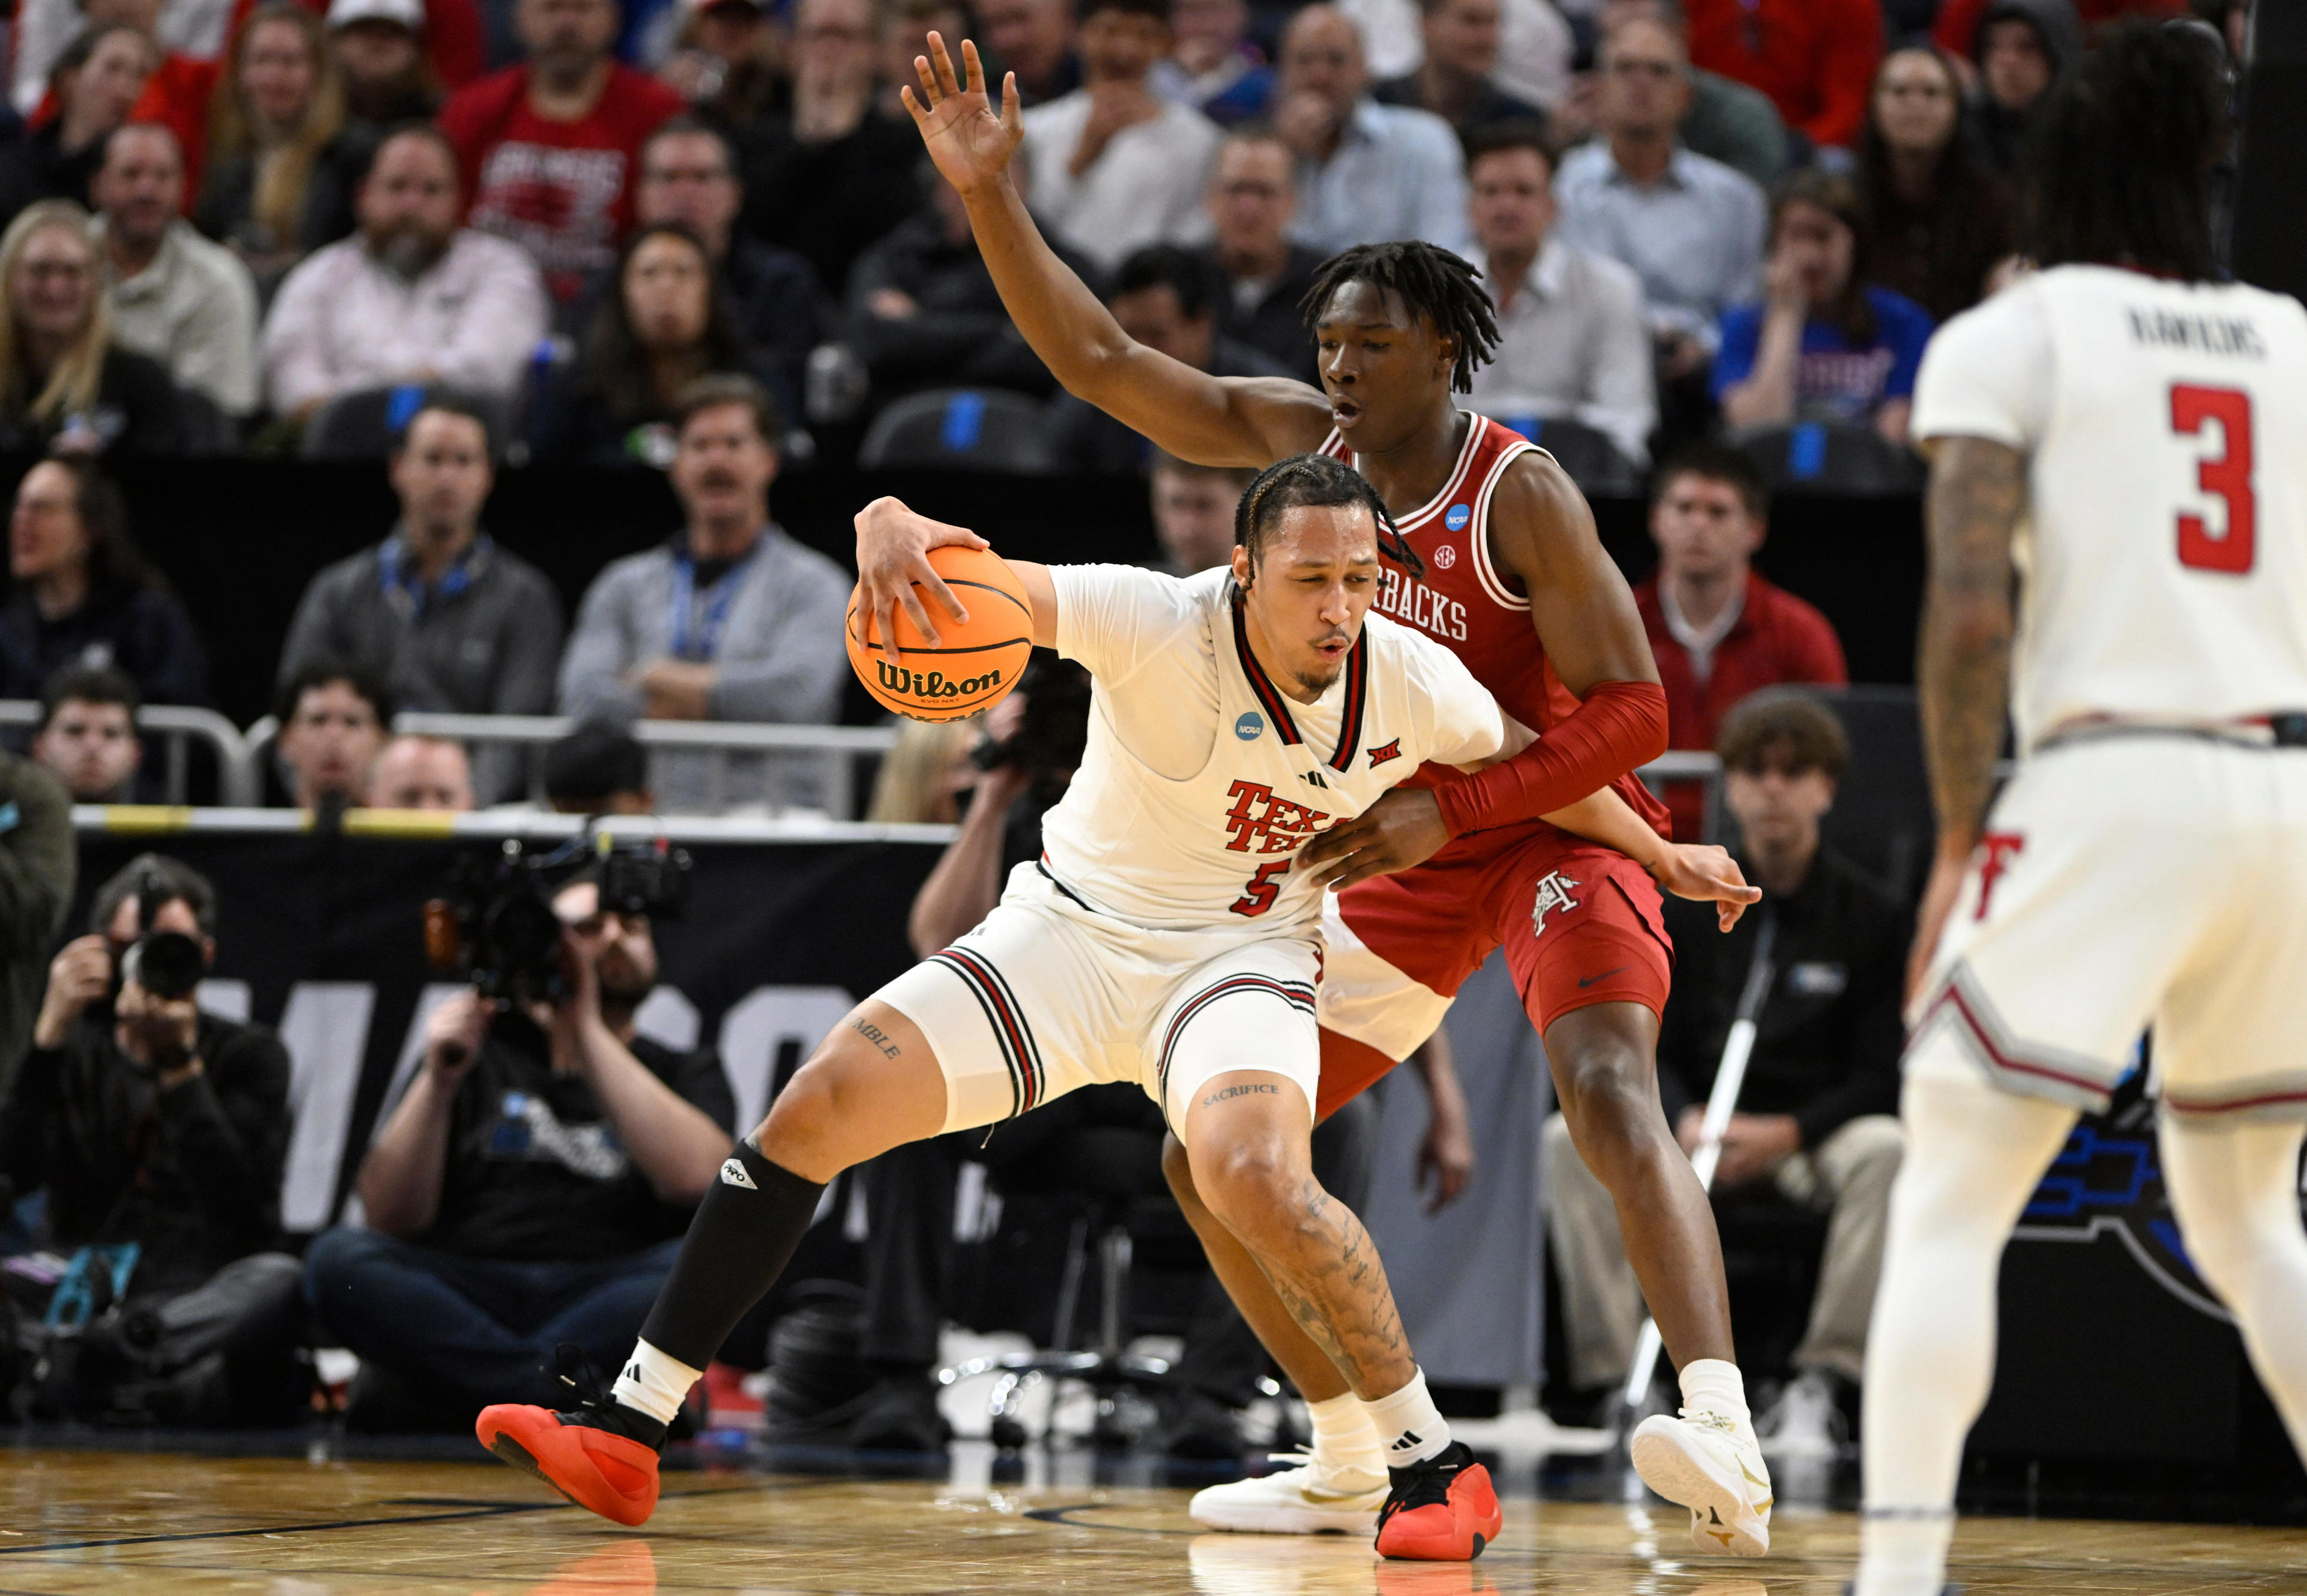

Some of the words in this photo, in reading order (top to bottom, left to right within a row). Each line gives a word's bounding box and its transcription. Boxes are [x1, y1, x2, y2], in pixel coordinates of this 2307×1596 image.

[2170, 383, 2255, 574] 3
[1447, 516, 1469, 524] NCAA
[1436, 547, 1454, 566] SEC
[876, 659, 1002, 698] Wilson
[1238, 725, 1261, 734] NCAA
[1229, 858, 1293, 917] 5
[1203, 1084, 1280, 1109] SACRIFICE
